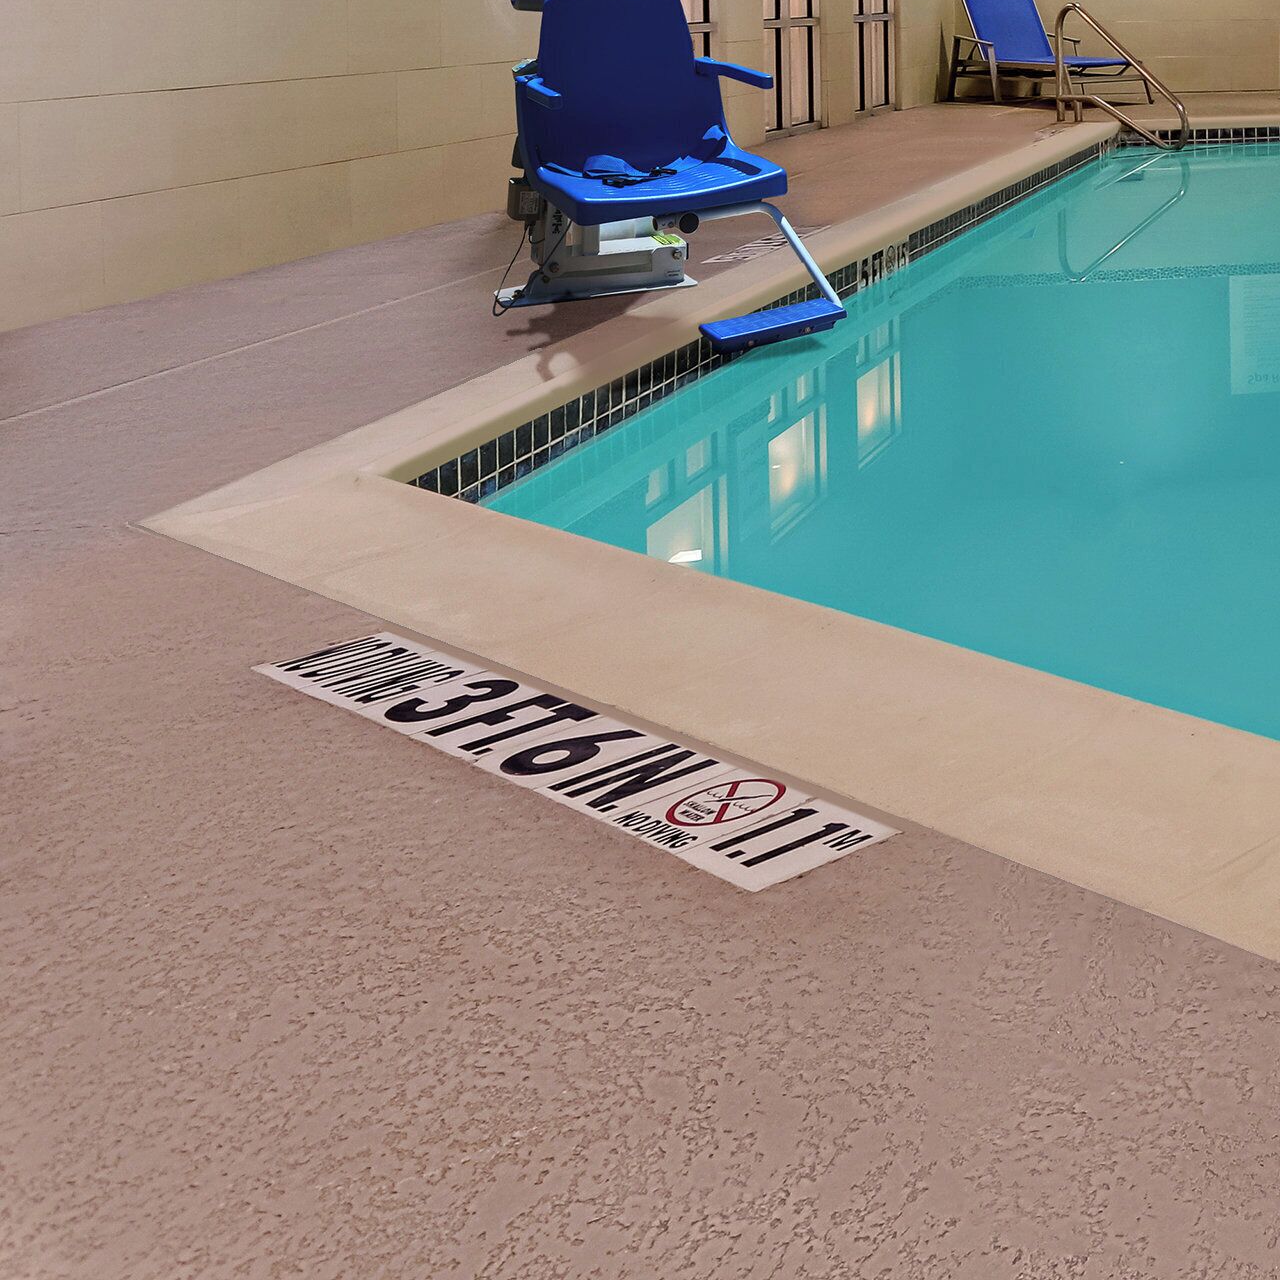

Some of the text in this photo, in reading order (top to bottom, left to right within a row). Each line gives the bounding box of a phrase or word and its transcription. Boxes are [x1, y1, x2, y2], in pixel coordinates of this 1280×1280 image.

[872, 249, 884, 282] FT
[384, 679, 520, 723] 3
[499, 729, 648, 777] 6
[678, 809, 705, 822] WATER
[683, 801, 717, 815] SHALLOW
[612, 810, 699, 849] NO DIVING
